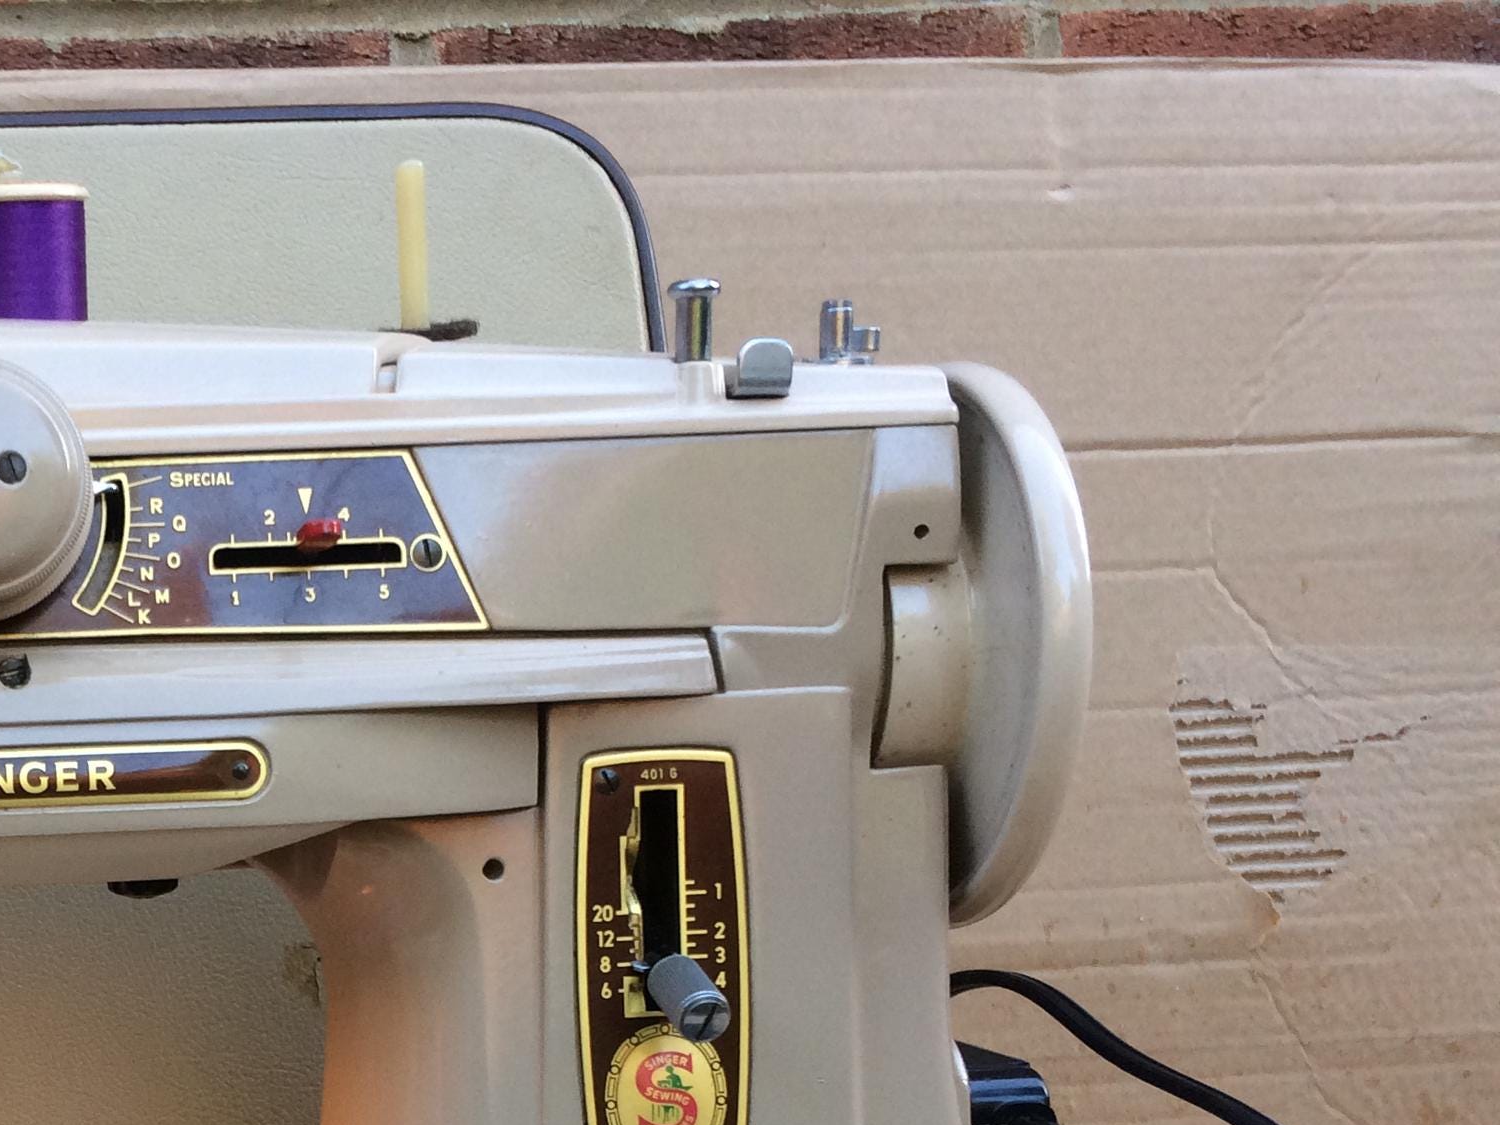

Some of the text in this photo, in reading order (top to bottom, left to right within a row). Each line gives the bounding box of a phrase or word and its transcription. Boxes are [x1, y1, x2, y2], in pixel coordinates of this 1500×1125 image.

[150, 497, 163, 514] R
[337, 506, 350, 522] 4
[172, 515, 186, 532] Q
[264, 509, 275, 525] 2
[148, 532, 160, 548] P
[167, 552, 181, 569] O
[140, 566, 154, 581] N
[128, 590, 141, 607] L
[155, 588, 169, 604] M
[231, 590, 240, 606] 1
[304, 587, 316, 603] 3
[379, 584, 390, 600] 5
[138, 608, 151, 625] K
[640, 767, 664, 780] 401
[714, 882, 723, 900] 1
[592, 905, 614, 923] 20
[597, 930, 615, 948] 12
[713, 922, 725, 939] 2
[715, 947, 726, 964] 3
[600, 956, 612, 974] 8
[715, 971, 727, 989] 4
[600, 982, 612, 1000] 6
[643, 1054, 688, 1071] SINGER
[644, 1086, 690, 1106] SEWING
